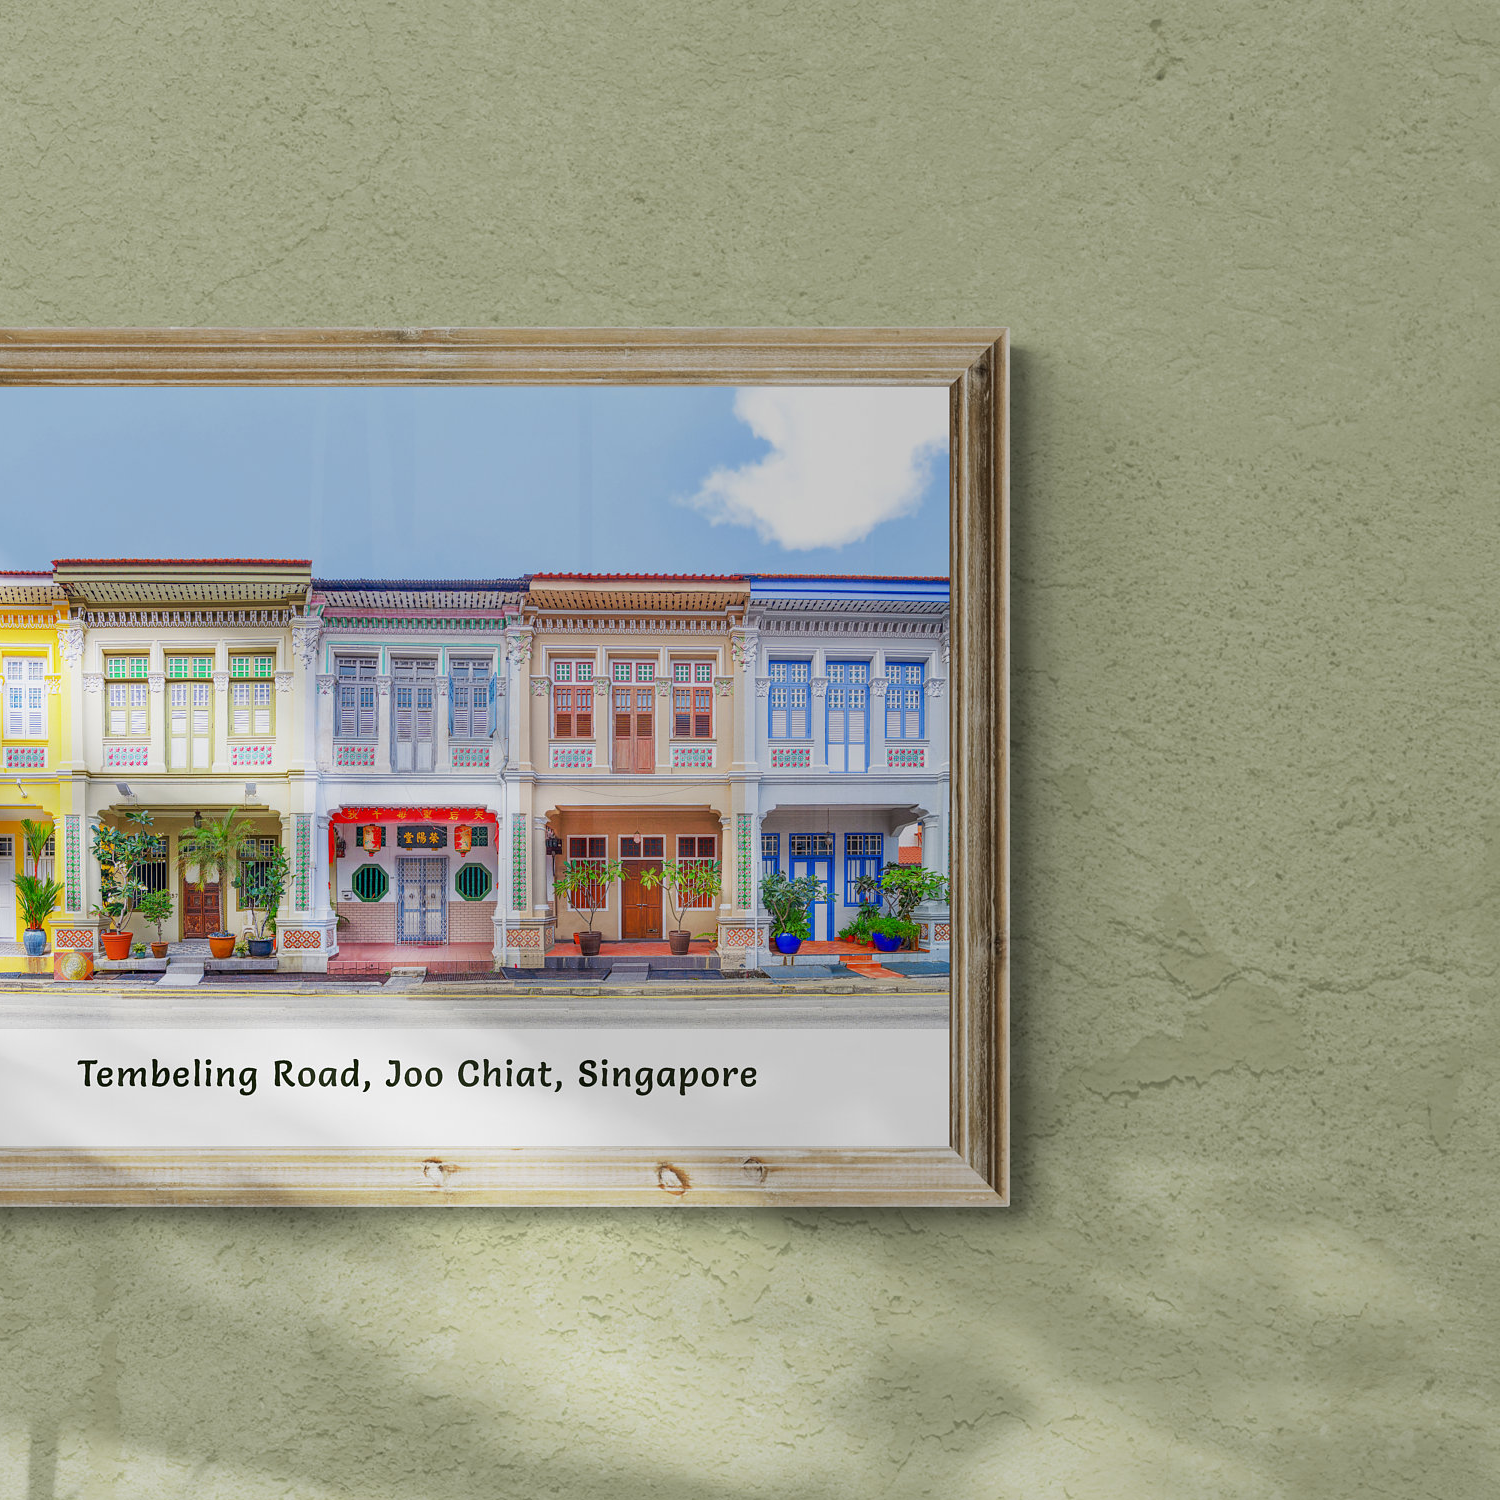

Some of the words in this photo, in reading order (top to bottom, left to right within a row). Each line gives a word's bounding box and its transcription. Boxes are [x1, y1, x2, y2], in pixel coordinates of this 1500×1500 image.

[77, 1058, 258, 1096] Tembeling
[274, 1058, 371, 1093] Road,
[385, 1059, 443, 1088] Joo
[457, 1058, 563, 1093] Chiat,
[578, 1058, 757, 1097] Singapore
